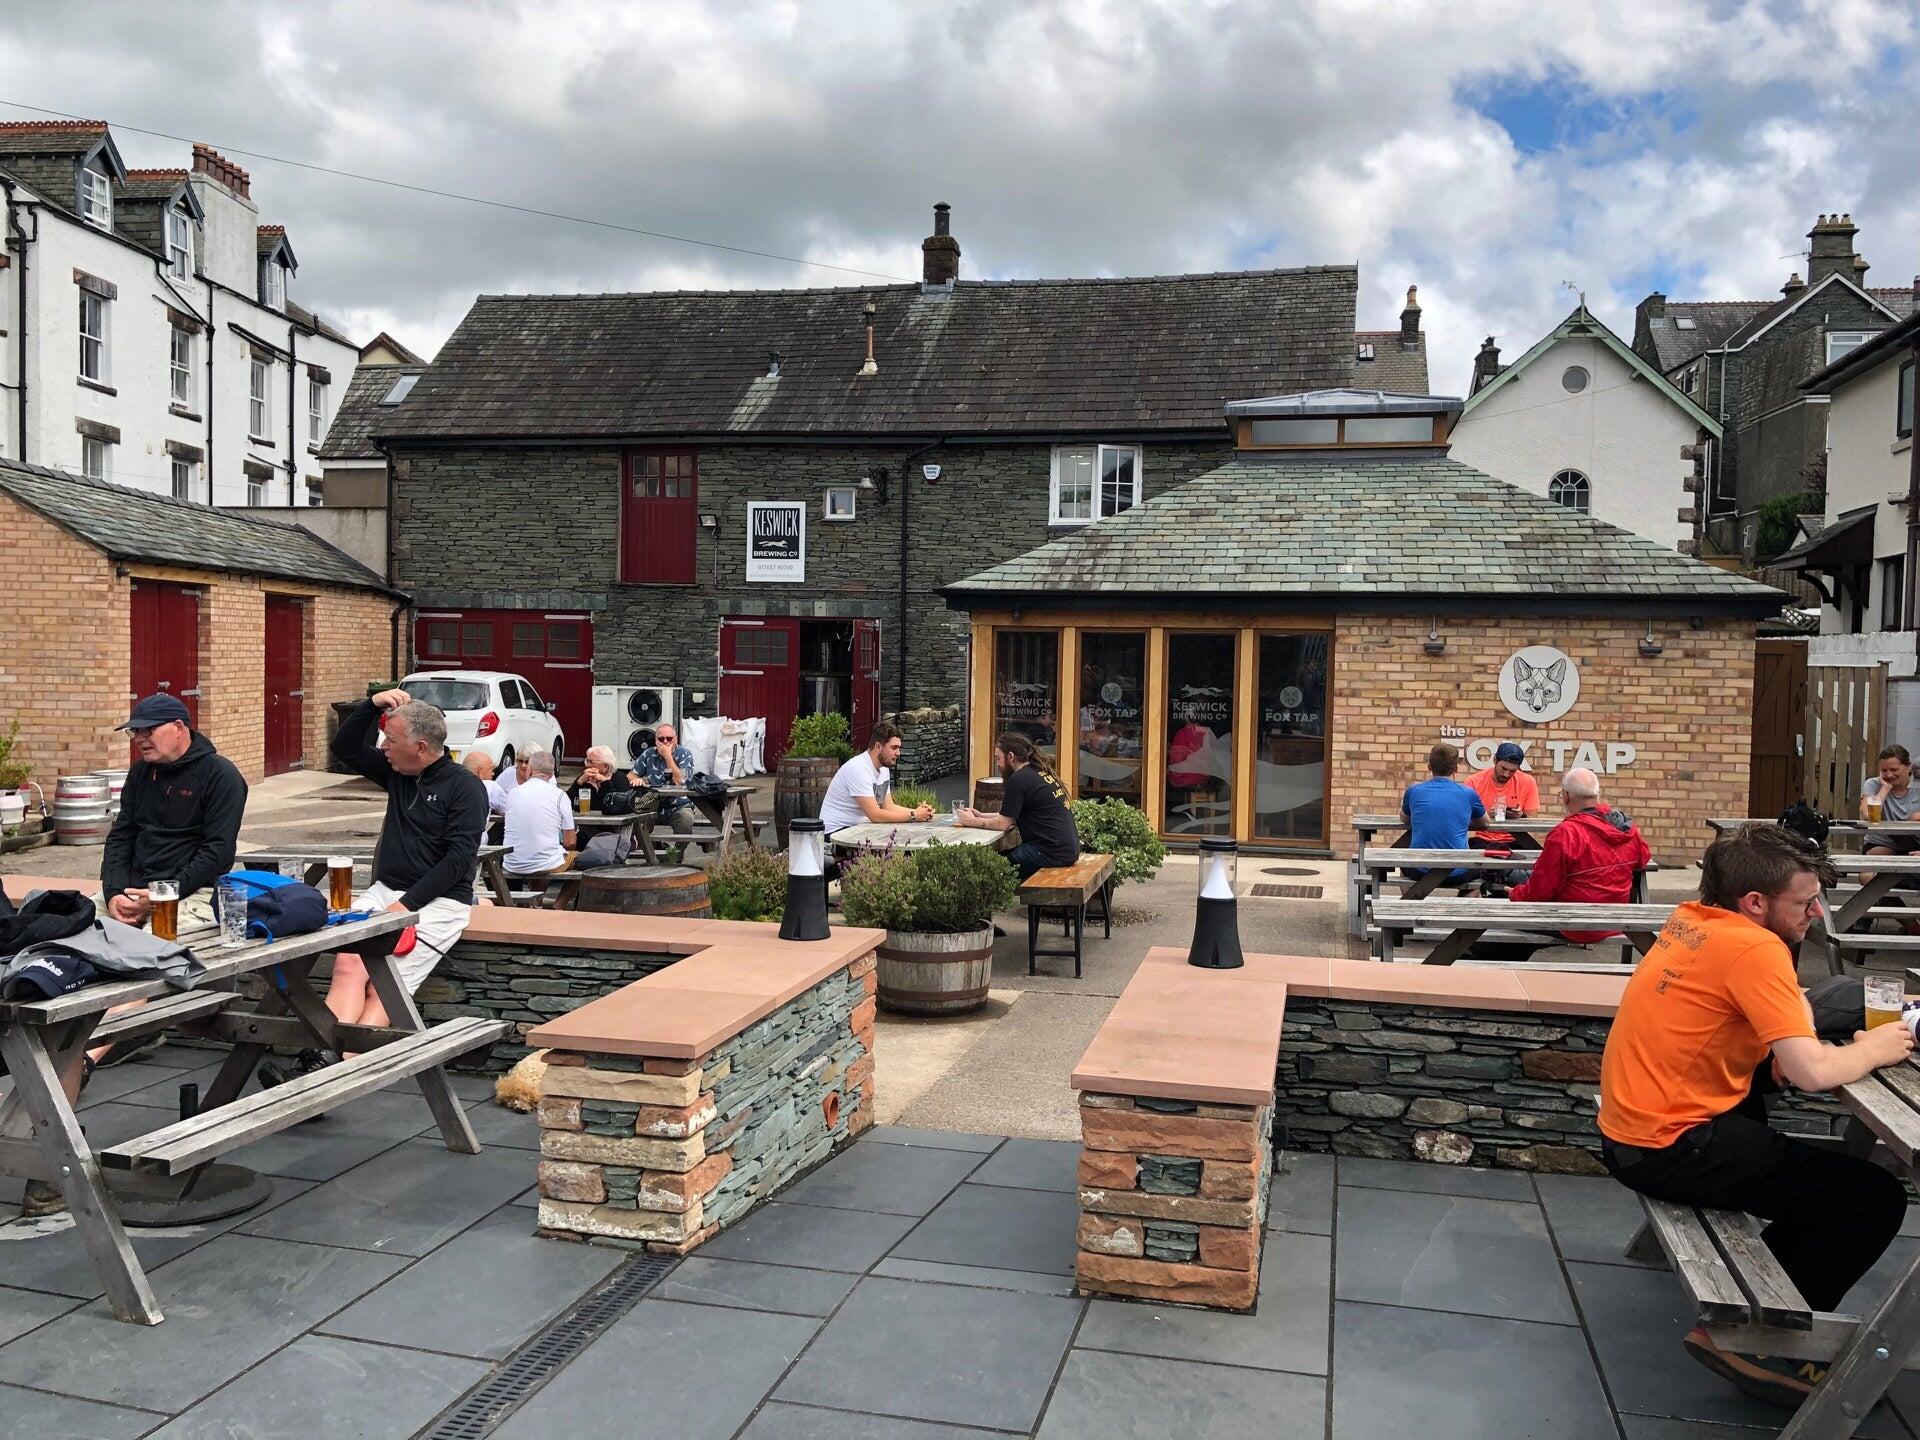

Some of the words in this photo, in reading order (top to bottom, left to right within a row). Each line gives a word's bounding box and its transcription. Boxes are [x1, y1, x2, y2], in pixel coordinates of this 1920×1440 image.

[754, 510, 798, 536] KESWICK
[1001, 697, 1052, 707] KESWICK
[1172, 701, 1227, 711] KESWICK
[1000, 707, 1039, 716] BREWING
[1088, 707, 1112, 718] FOX
[1114, 708, 1138, 718] TAP
[1172, 712, 1214, 720] BREWING
[1265, 712, 1291, 722] FOX
[1293, 713, 1318, 722] TAP
[1440, 725, 1467, 737] the
[1546, 741, 1637, 774] TAP
